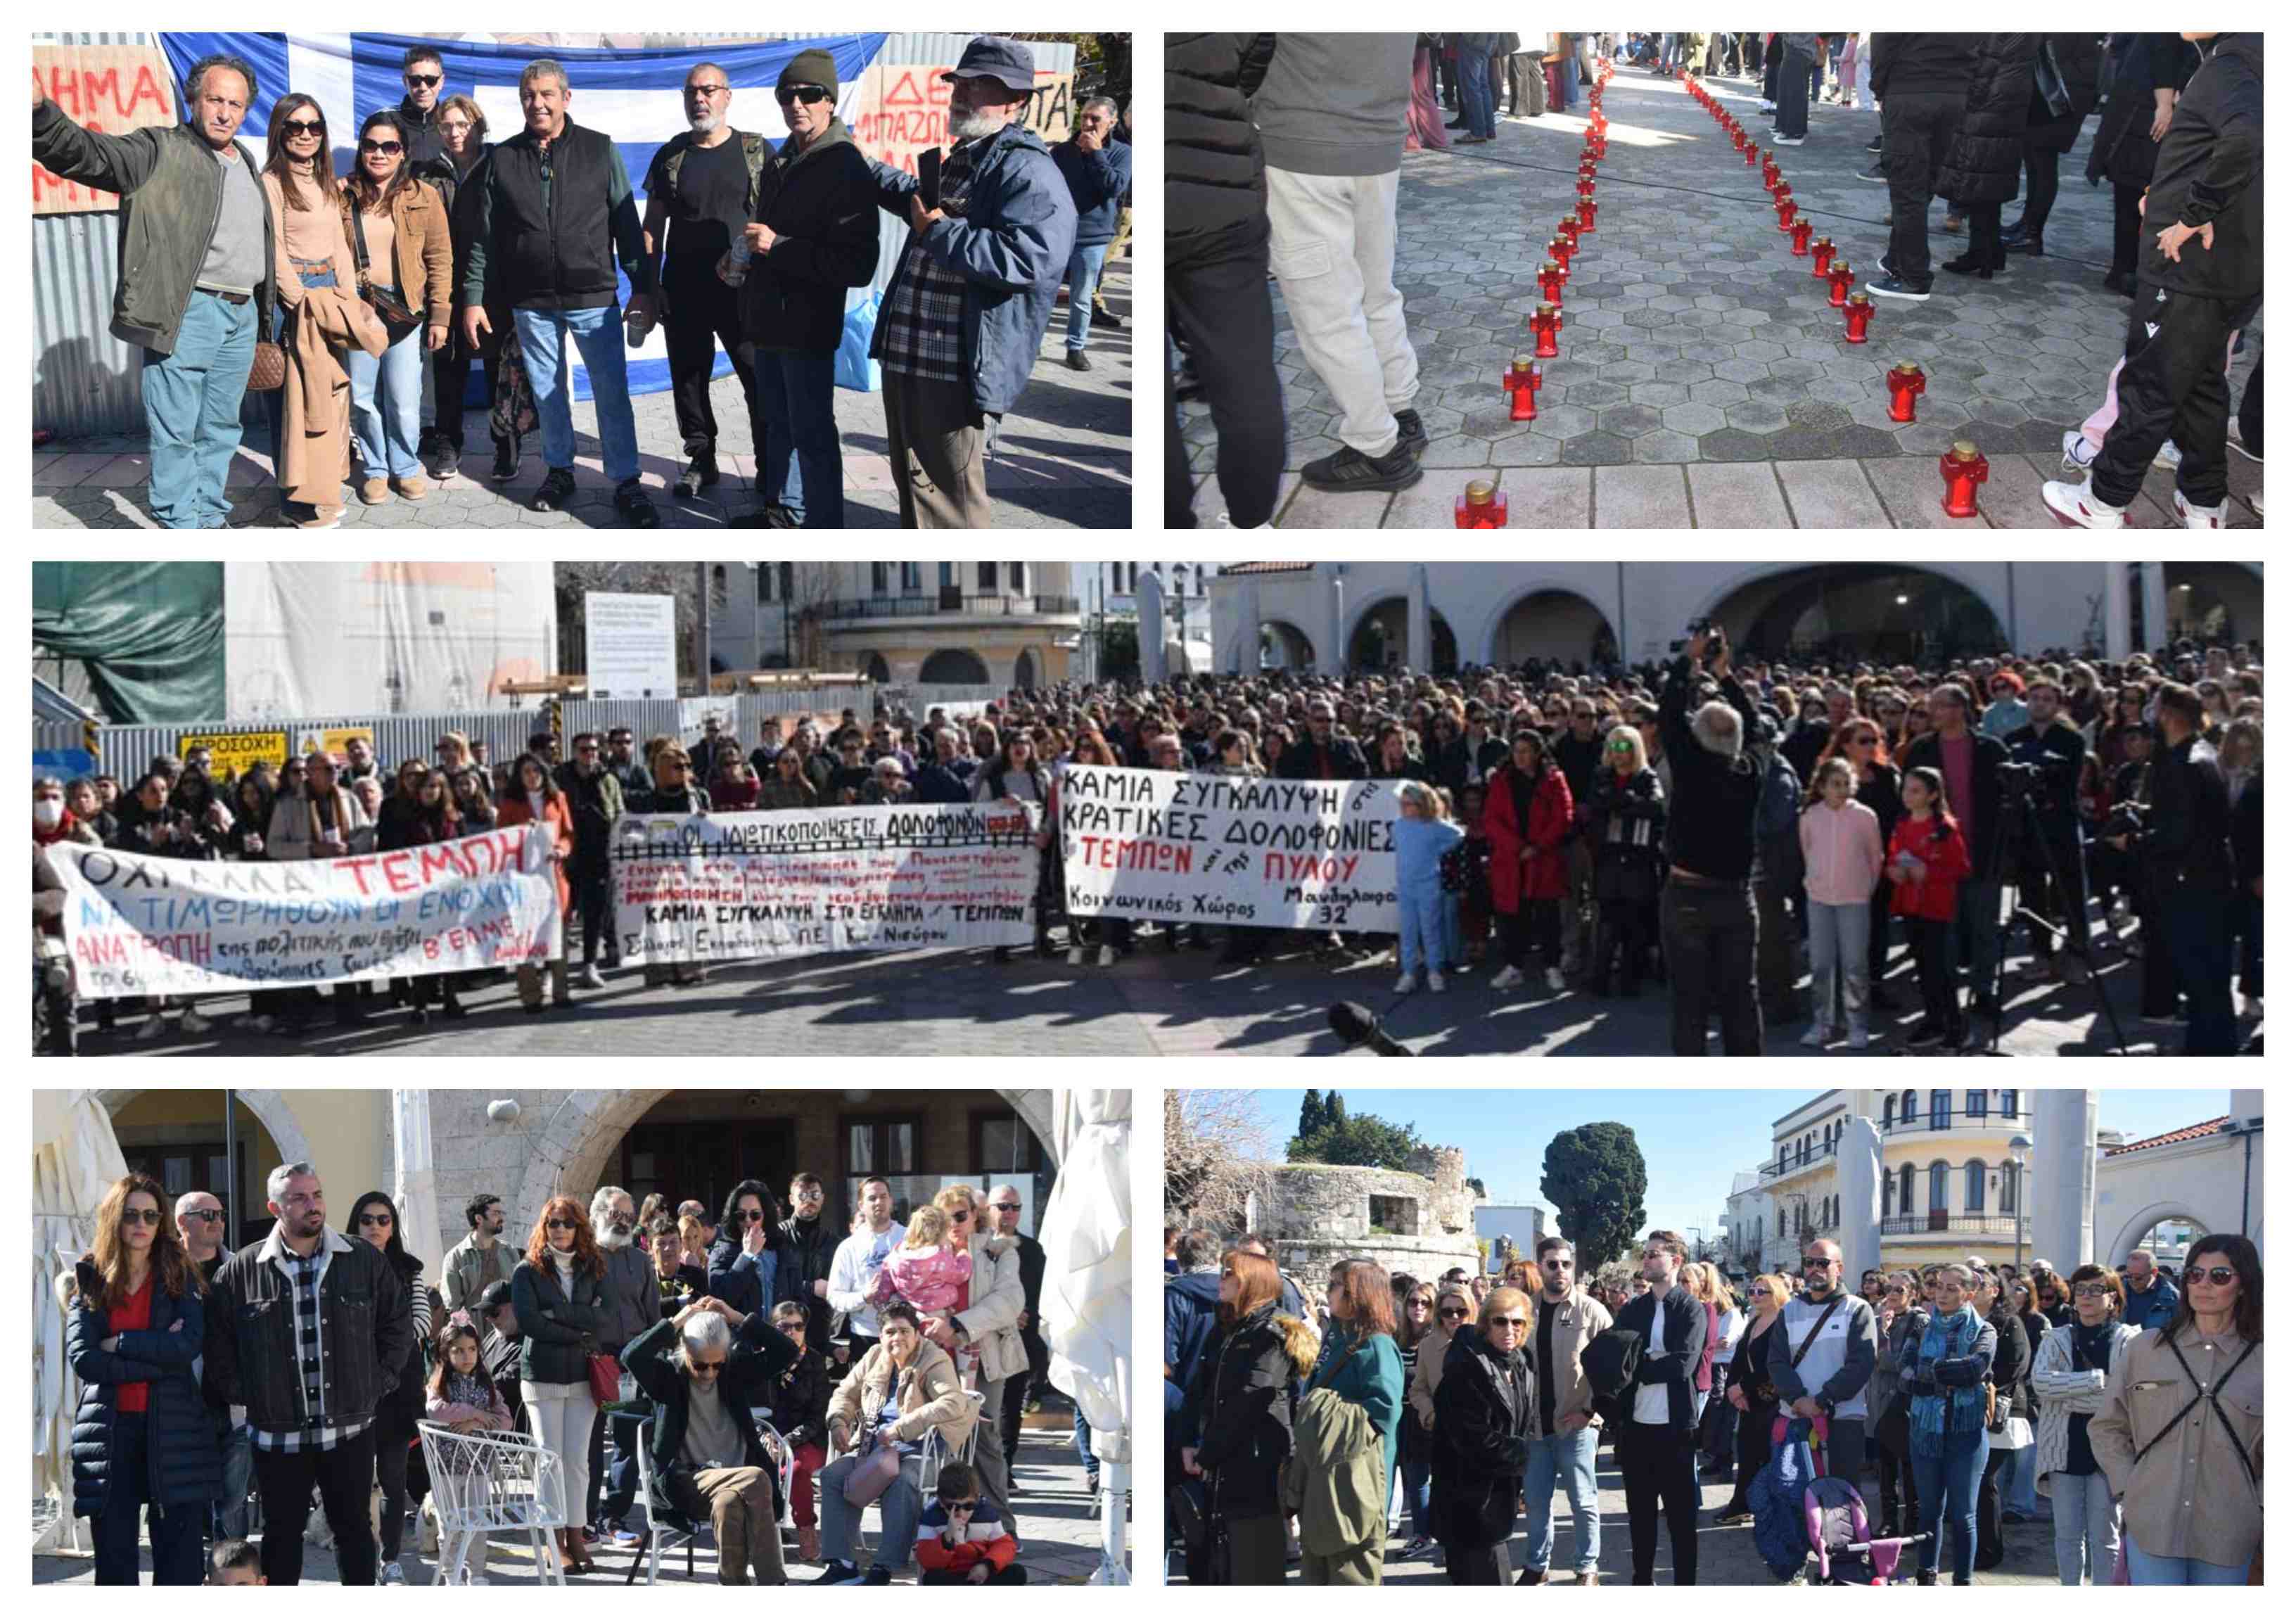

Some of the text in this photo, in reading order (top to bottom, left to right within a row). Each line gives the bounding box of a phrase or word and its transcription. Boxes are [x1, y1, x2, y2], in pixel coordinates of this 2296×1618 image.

[1063, 770, 1153, 802] ΚΑΜΙΑ
[1172, 779, 1338, 814] ΣΥΓΚΑΛΥΨΗ
[723, 817, 877, 844] ΙΔΙΩΤΙΚΟΠΟΙΗΣΕΙΣ
[1063, 802, 1396, 853] ΚΡΑΤΙΚΕΣ ΔΟΛΟΦΟΝΙΕΣ
[81, 851, 169, 888] ΟΧΙ
[333, 829, 526, 896] ΤΕΜΠΗ
[1080, 836, 1192, 875] ΤΕΜΠΩΝ
[1264, 852, 1358, 884] ΠΥΛΟΥ
[141, 896, 362, 929] ΤΙΜΩΡΗΘΟΥΝ
[419, 877, 523, 920] ΕΝΟΧΟΙ
[644, 905, 707, 924] ΚΑΜΙΑ
[716, 905, 812, 924] ΣΥΓΚΑΛΥΨΗ
[1069, 884, 1182, 912] Κοινωνικός
[1192, 894, 1256, 919] Χώρος
[1319, 905, 1347, 924] 32
[75, 931, 213, 966] ΑΝΑΤΡΟΠΗ
